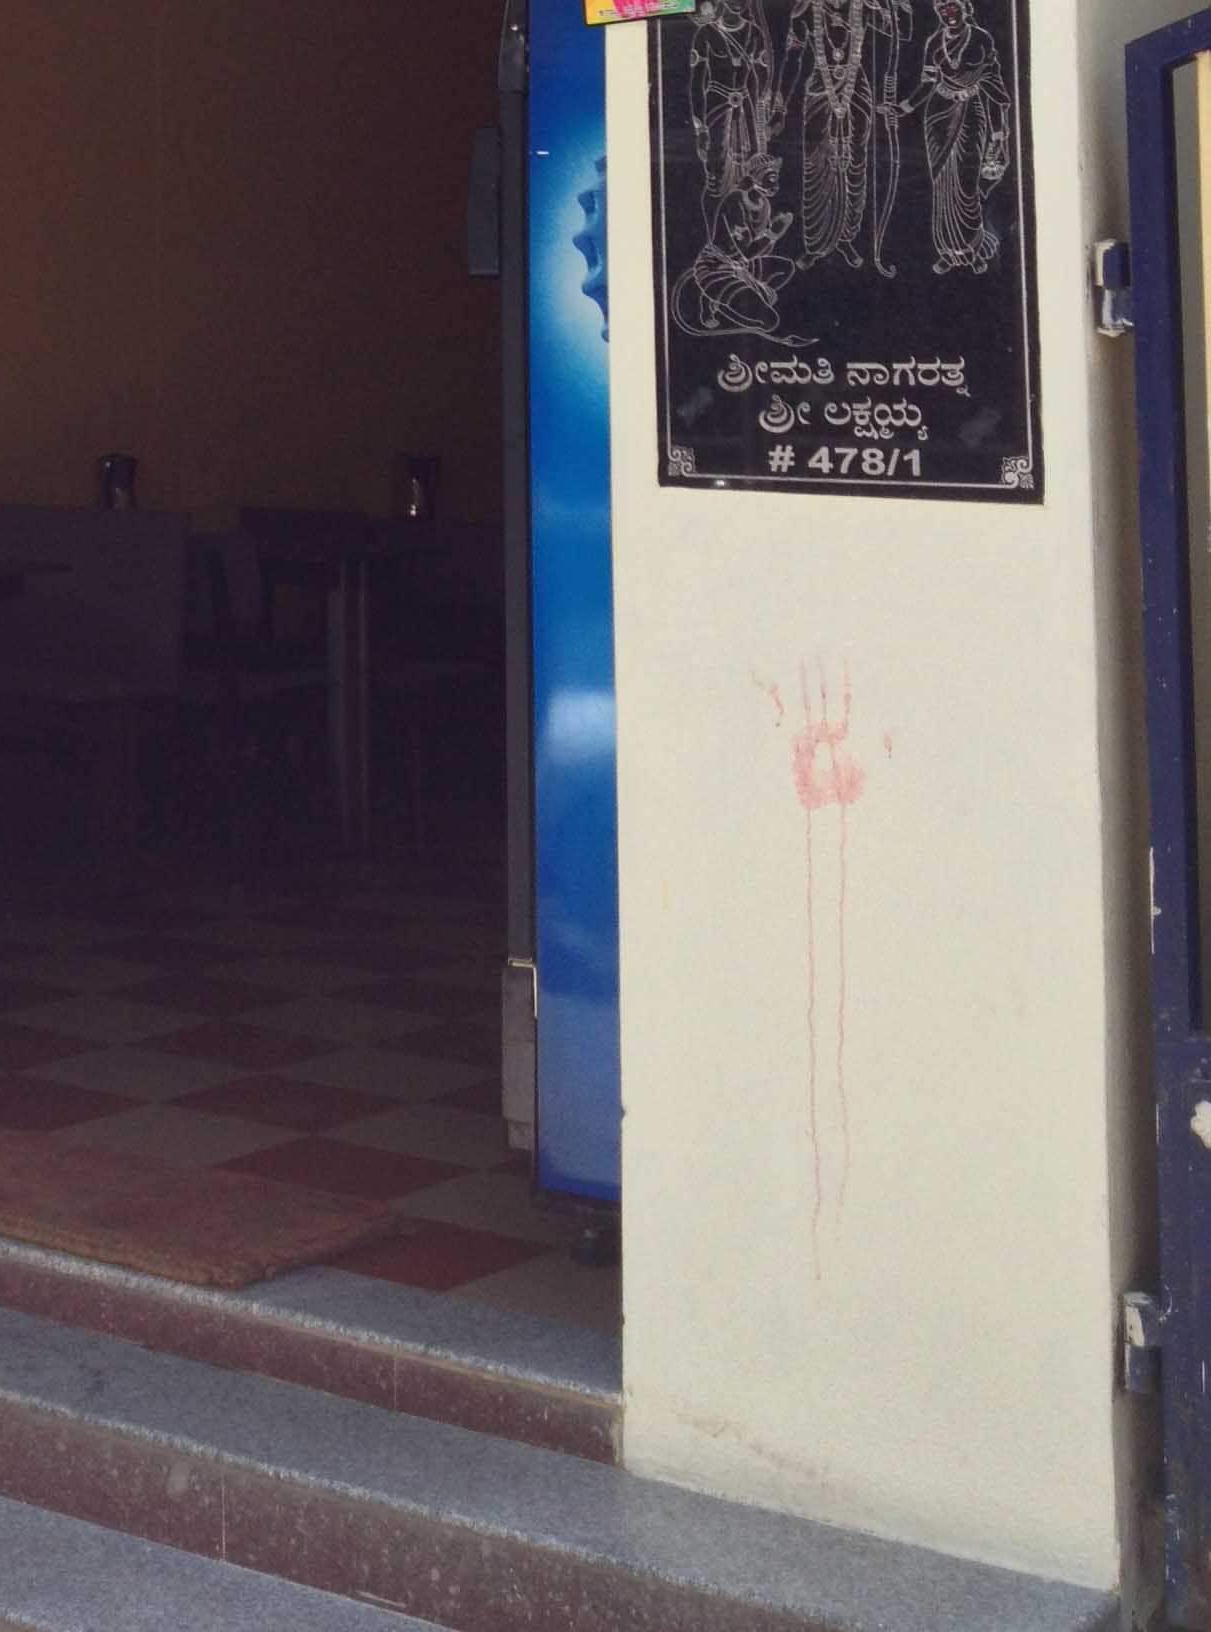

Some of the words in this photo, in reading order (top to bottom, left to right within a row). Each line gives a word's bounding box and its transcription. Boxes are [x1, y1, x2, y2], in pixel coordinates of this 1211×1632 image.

[717, 353, 835, 393] ಶ್ರೀಮತಿ
[846, 355, 971, 397] ನಾಗರತ್ನ
[759, 394, 811, 434] ಶ್ರೀ
[768, 445, 796, 473] #
[808, 445, 922, 477] 478/1
